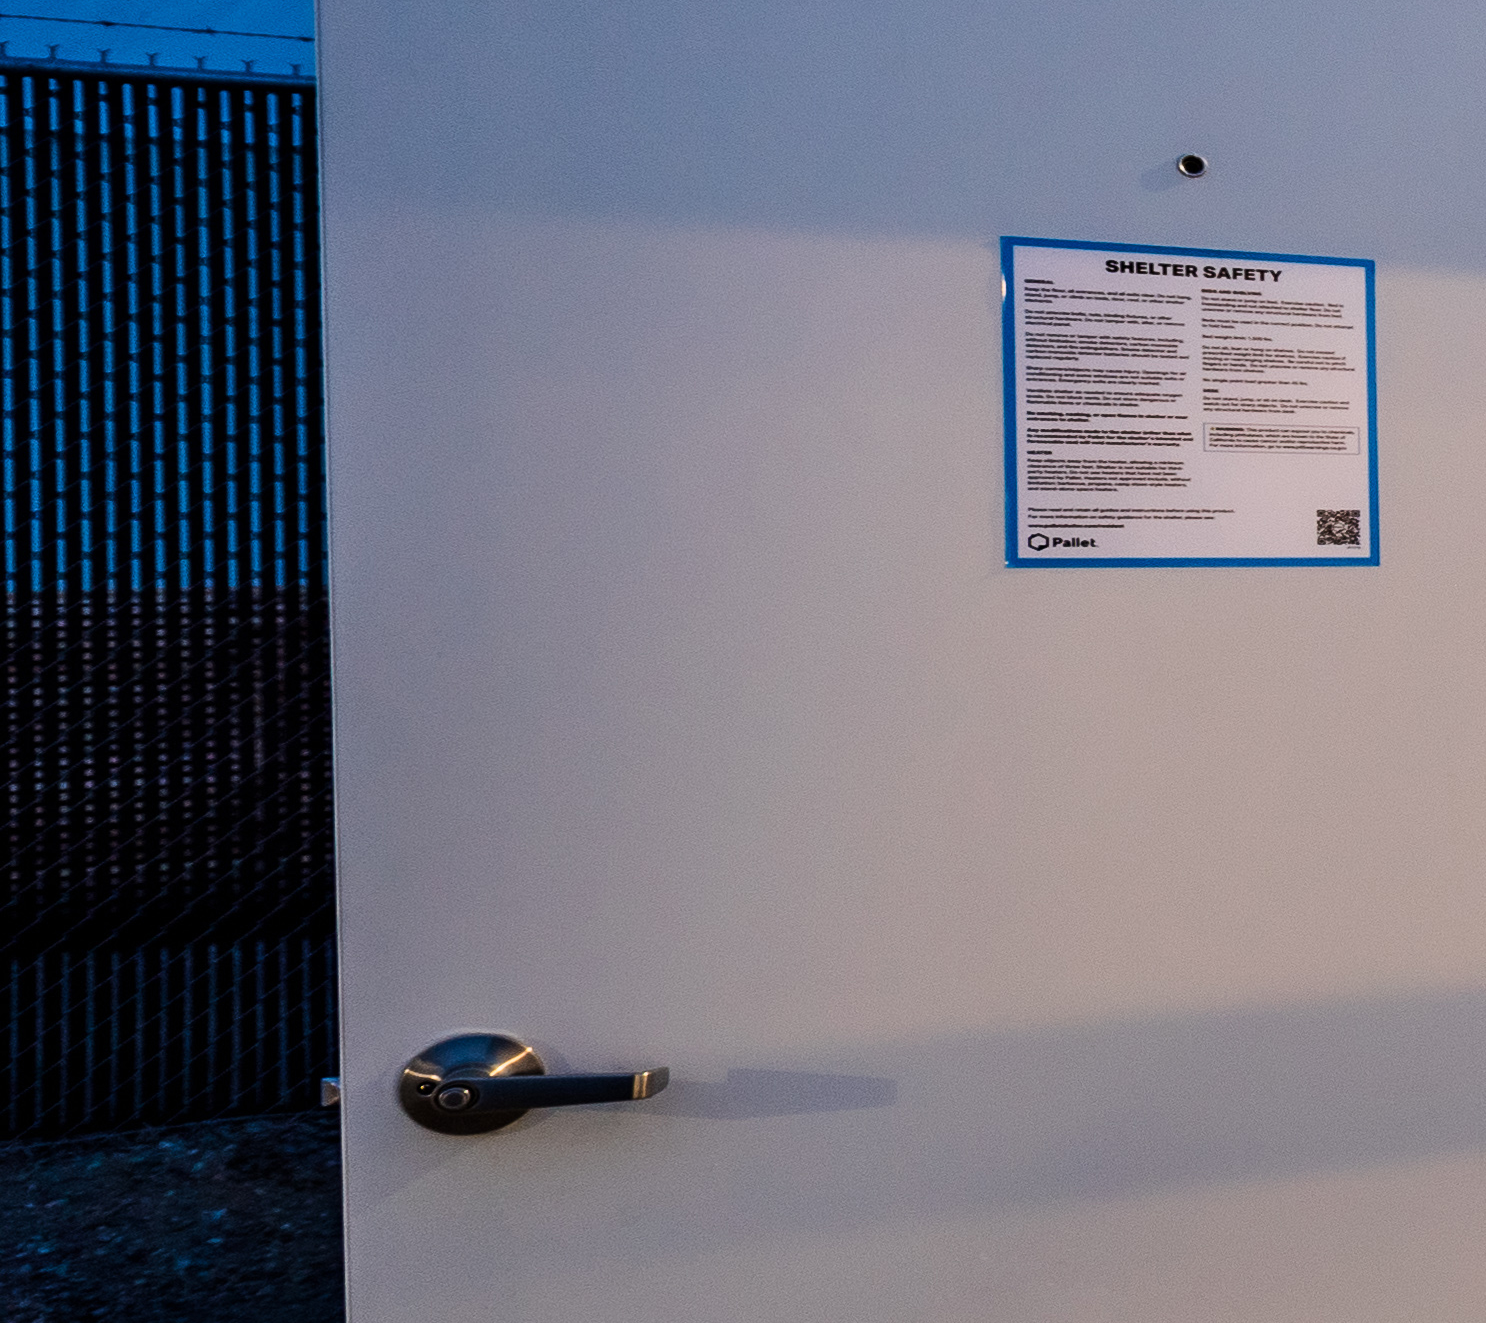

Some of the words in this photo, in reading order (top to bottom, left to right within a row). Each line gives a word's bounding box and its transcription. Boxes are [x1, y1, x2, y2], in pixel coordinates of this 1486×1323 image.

[1105, 259, 1198, 278] SHELTER
[1202, 265, 1282, 283] SAFETY
[1052, 537, 1097, 548] Pallet
